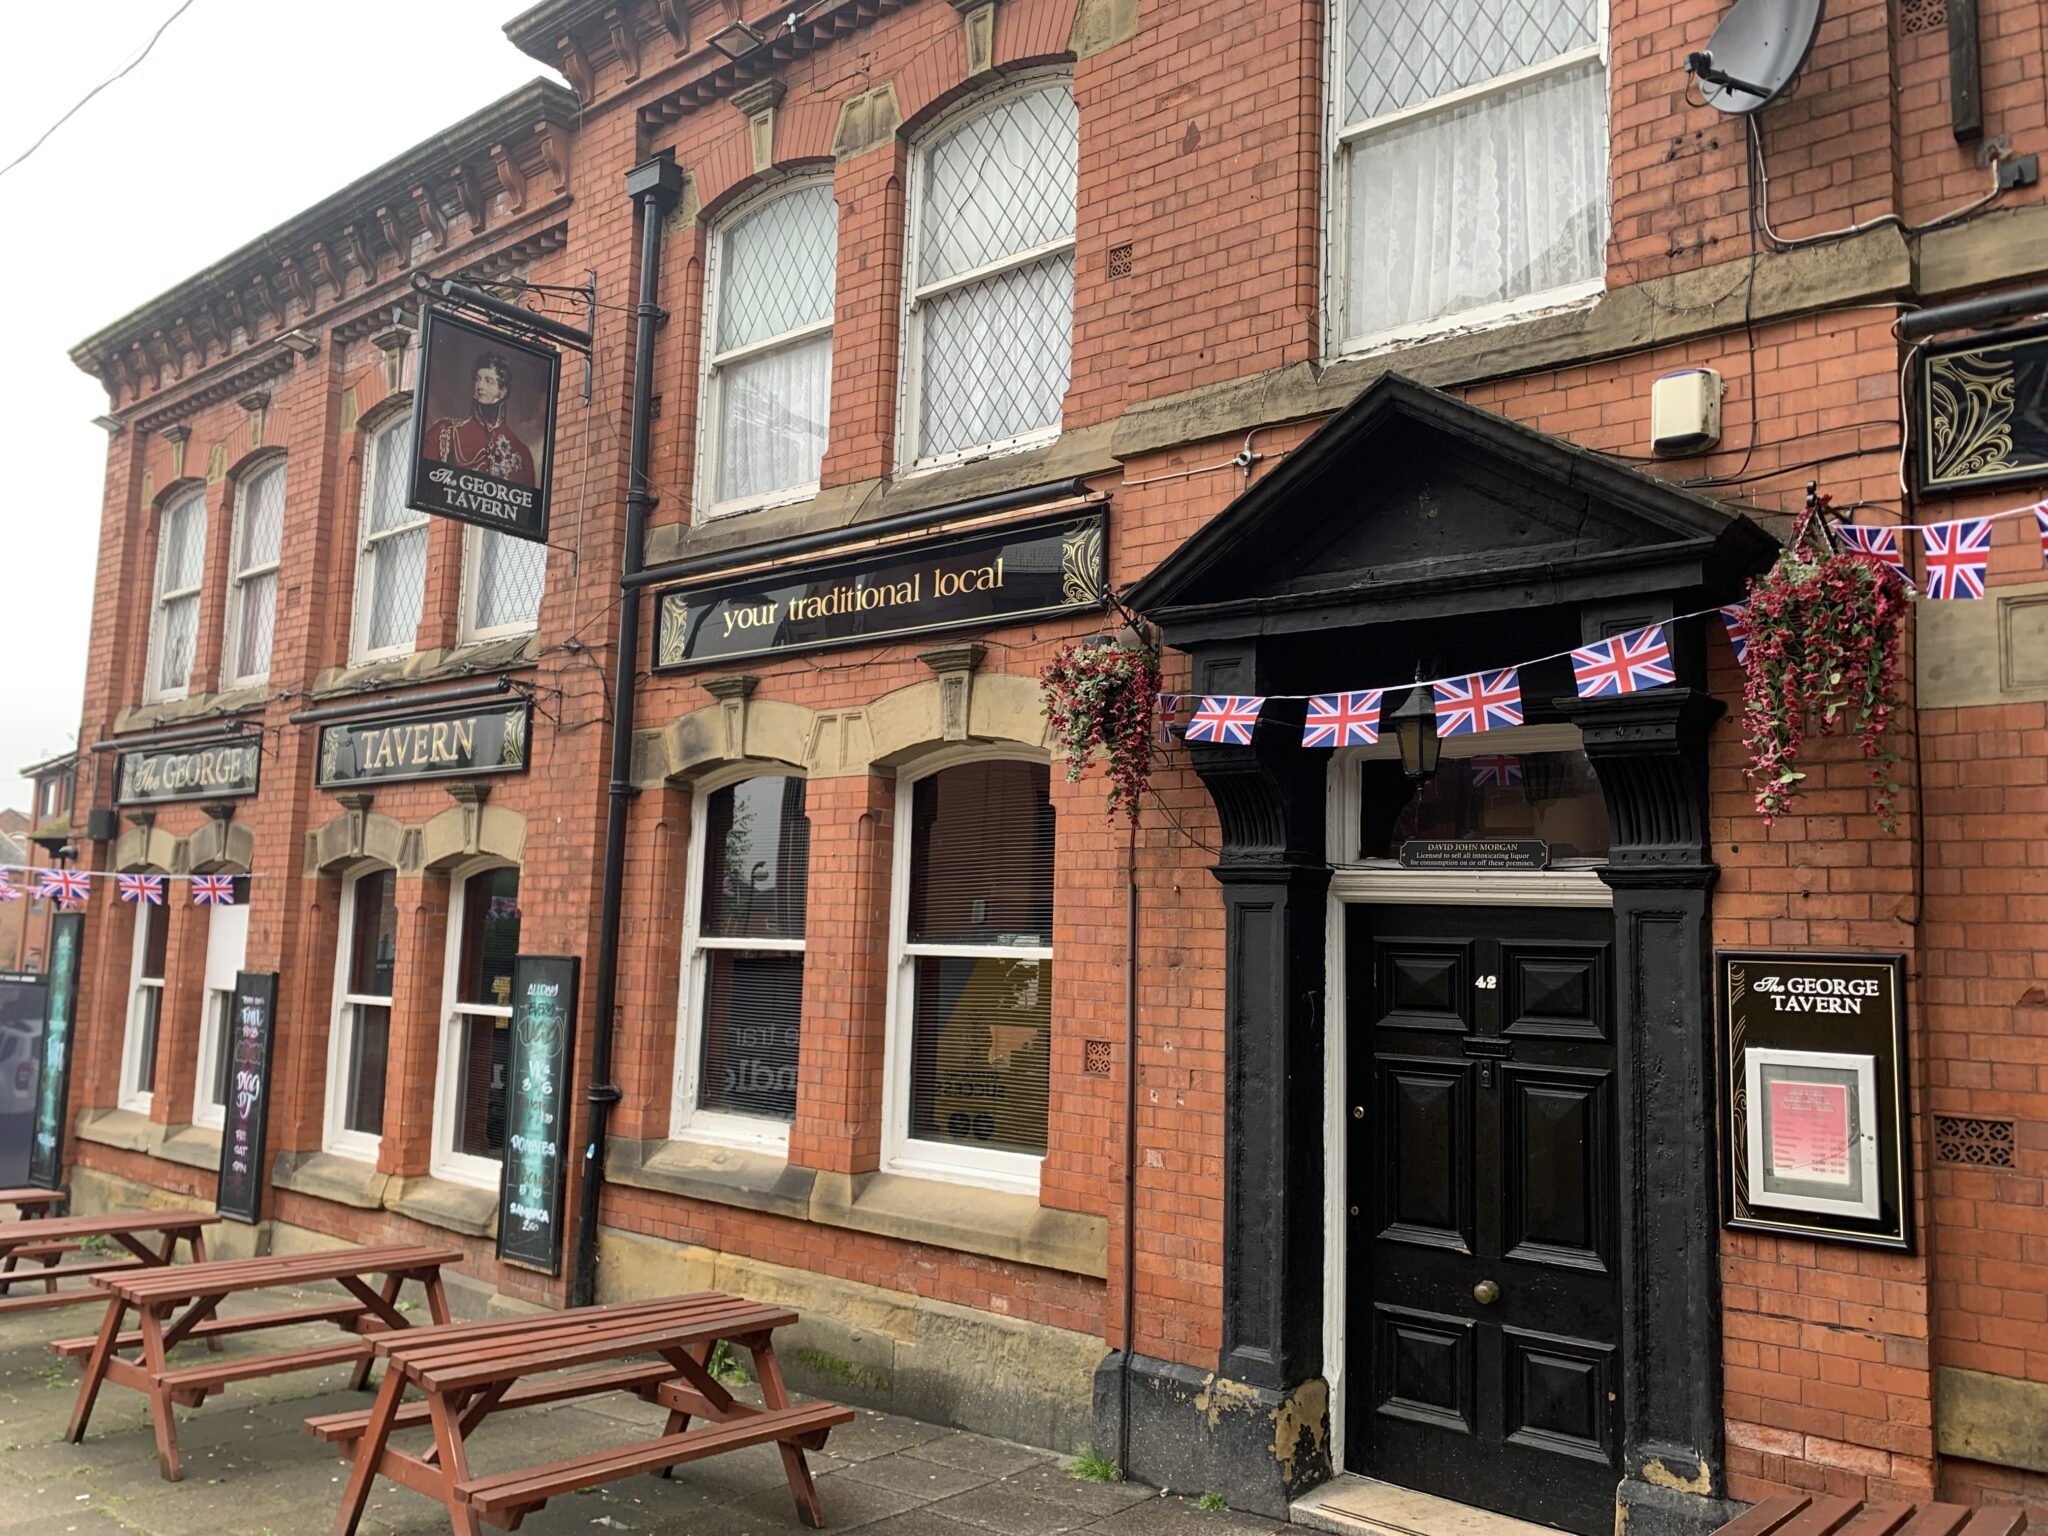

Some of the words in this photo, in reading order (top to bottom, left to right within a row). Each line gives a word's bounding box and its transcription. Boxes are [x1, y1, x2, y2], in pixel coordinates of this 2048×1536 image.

[429, 468, 458, 487] The
[459, 475, 533, 508] GEORGE
[443, 487, 518, 521] TAVERN
[723, 602, 779, 637] your
[788, 574, 921, 621] traditional
[933, 558, 1005, 598] local
[361, 718, 477, 769] TAVERN
[133, 758, 160, 792] The
[162, 747, 243, 789] GEORGE
[1428, 843, 1454, 851] DAVID
[1455, 843, 1478, 851] JOHN
[1479, 843, 1518, 851] MORGAN
[1472, 852, 1509, 861] intoxicating
[1510, 852, 1530, 861] liquor
[1420, 860, 1458, 868] consumption
[1477, 859, 1487, 867] off
[1488, 859, 1505, 867] these
[1506, 860, 1535, 868] premises.
[1475, 974, 1497, 989] 42
[1753, 976, 1786, 993] The
[1787, 977, 1880, 997] GEORGE
[1770, 994, 1862, 1014] TAVERN
